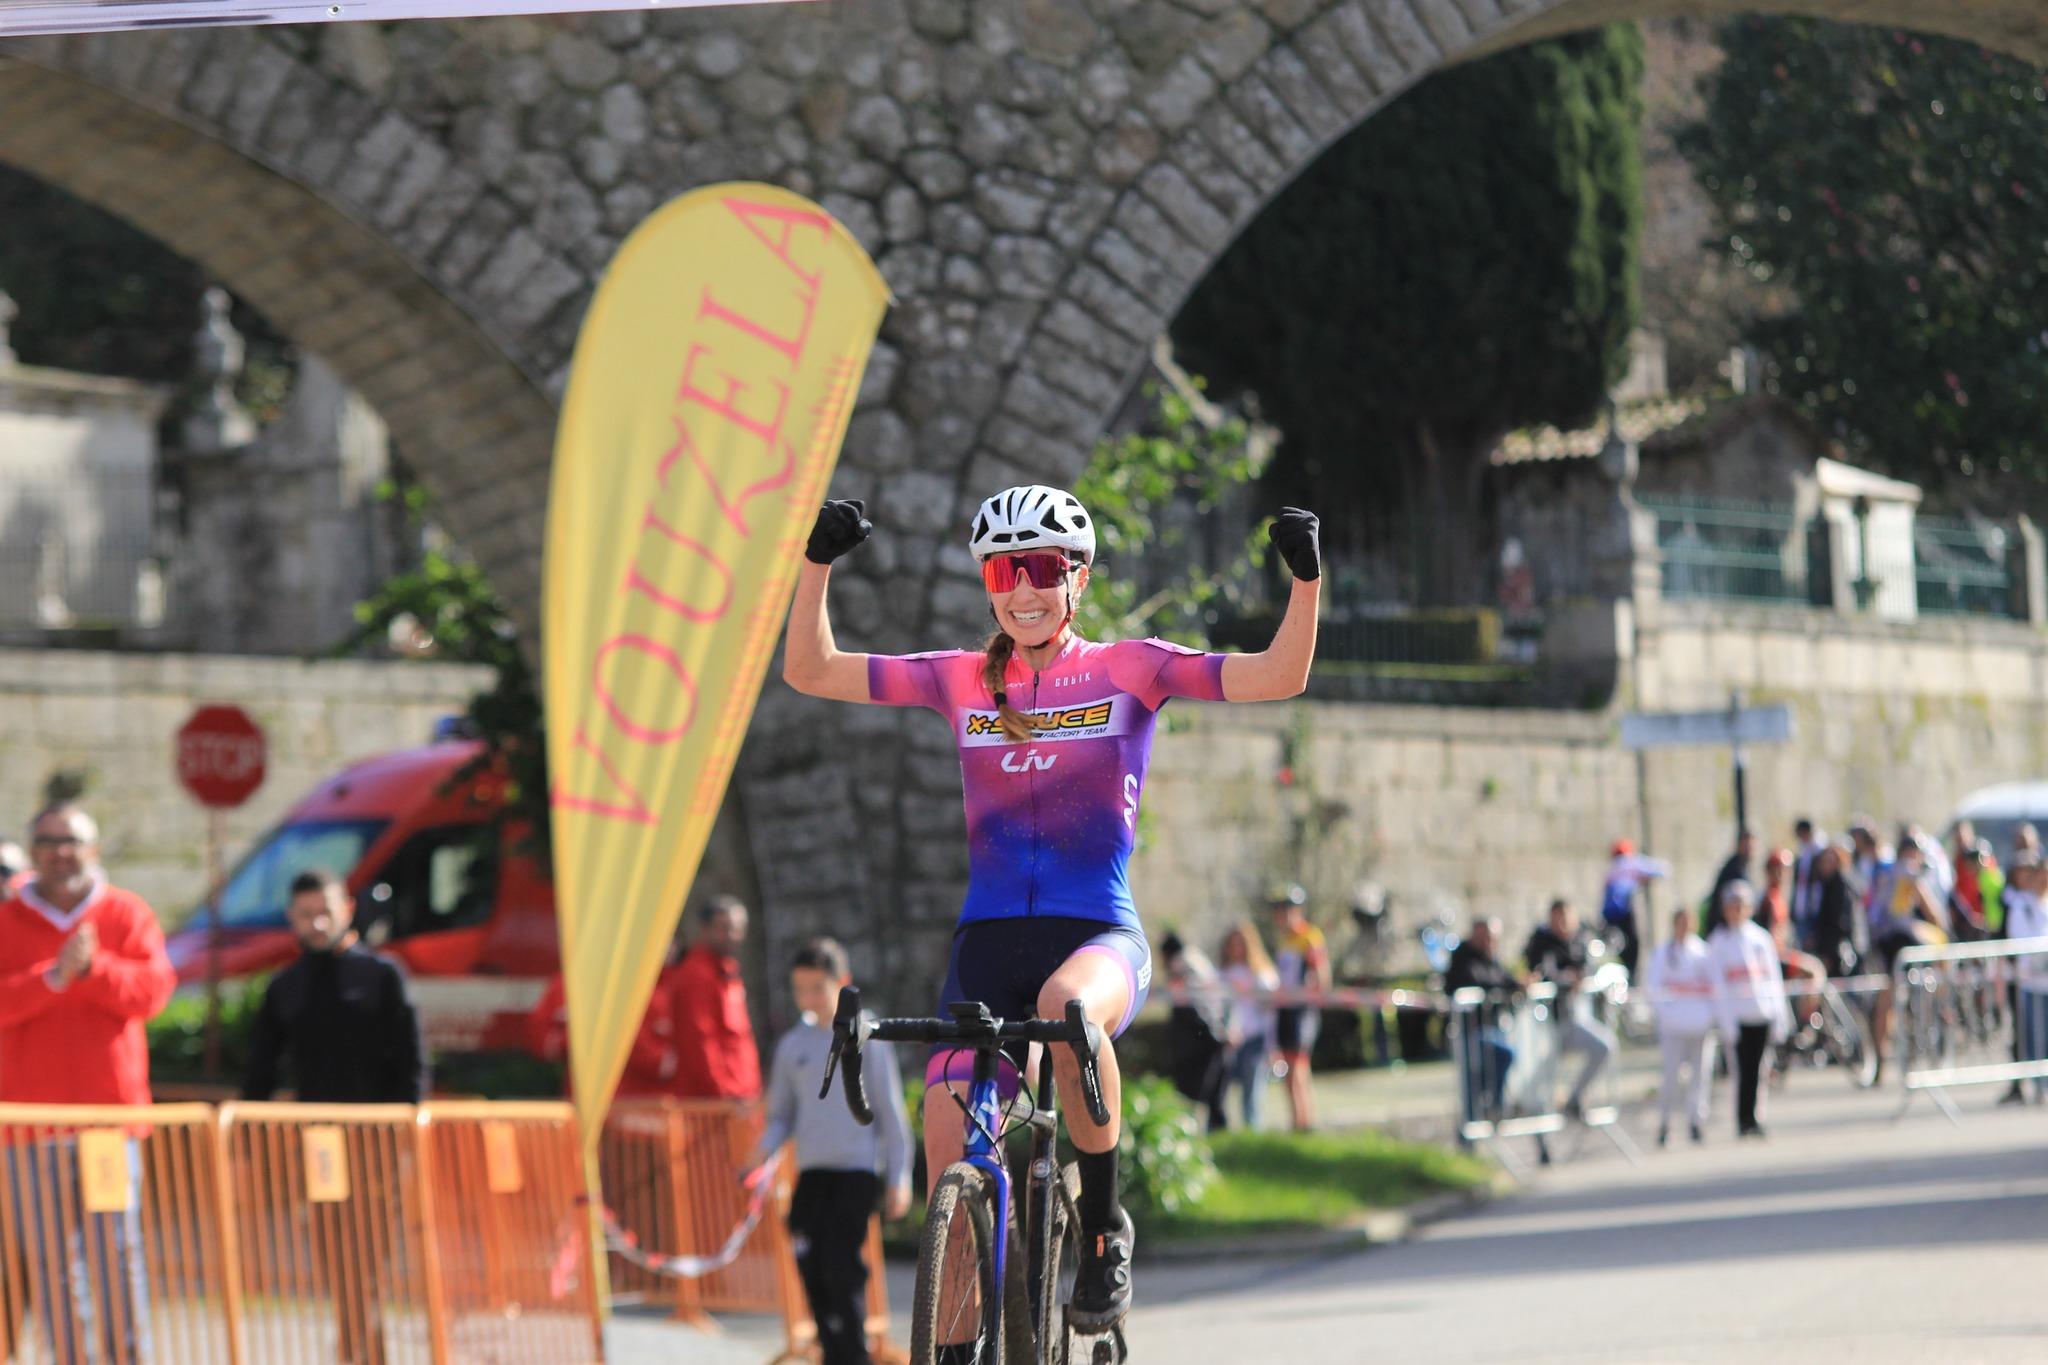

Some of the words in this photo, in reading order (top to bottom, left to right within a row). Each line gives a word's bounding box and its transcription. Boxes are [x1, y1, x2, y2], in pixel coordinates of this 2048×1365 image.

[549, 196, 832, 826] VOUZELA
[966, 701, 1112, 735] X-SUCE
[1043, 730, 1081, 739] FACTORY
[1084, 727, 1107, 736] TEAM
[179, 733, 264, 780] STOP
